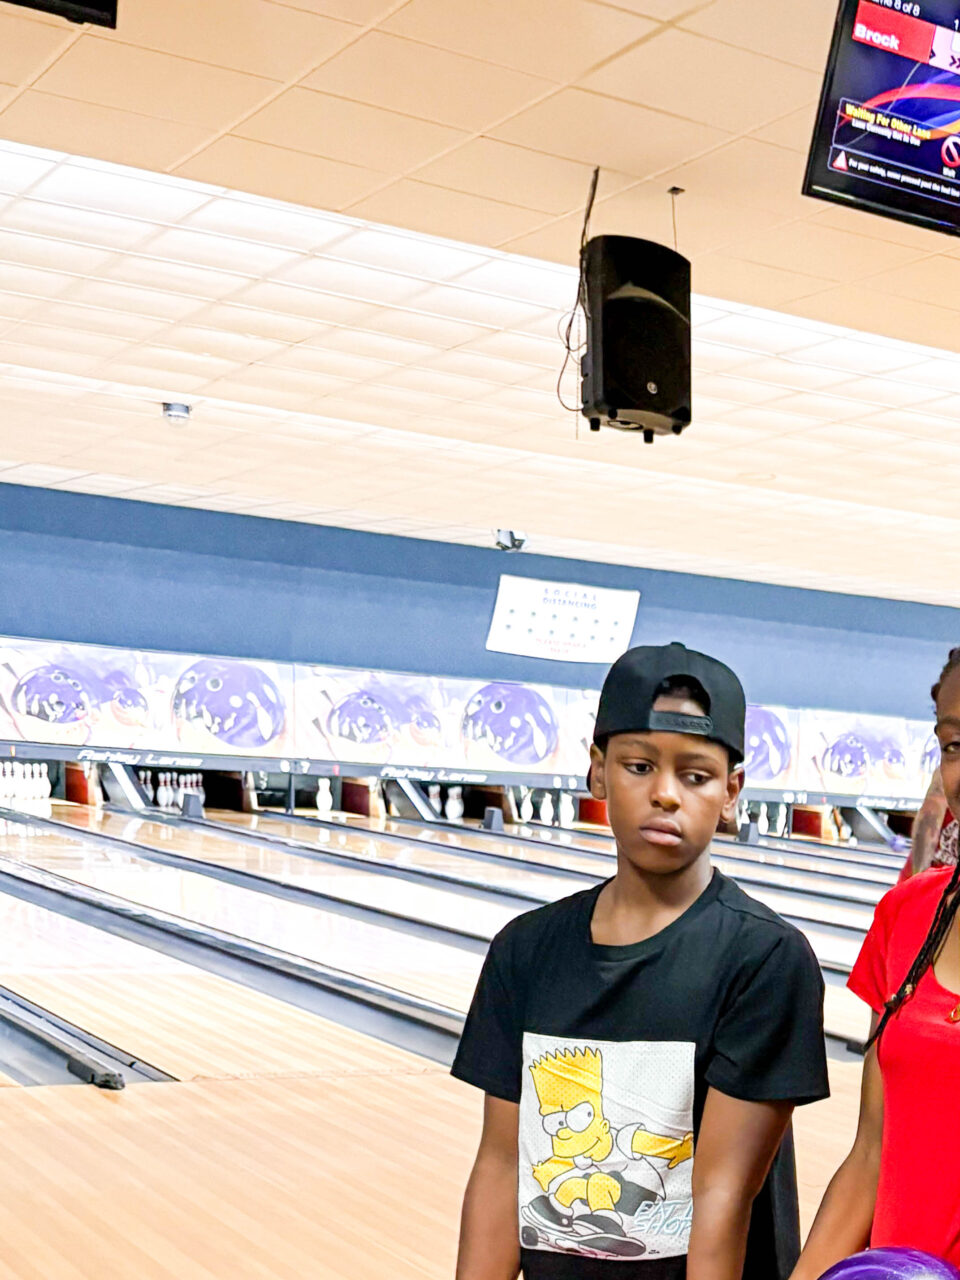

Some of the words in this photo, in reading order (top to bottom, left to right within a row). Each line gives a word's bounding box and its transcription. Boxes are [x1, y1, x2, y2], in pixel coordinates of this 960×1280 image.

[893, 0, 901, 10] 8
[902, 4, 913, 13] of
[912, 5, 920, 16] 8
[953, 19, 960, 31] 1
[854, 23, 900, 50] Brock
[891, 118, 912, 134] Other
[77, 749, 141, 765] Ashley
[145, 753, 203, 767] Lanes
[300, 761, 310, 774] 7
